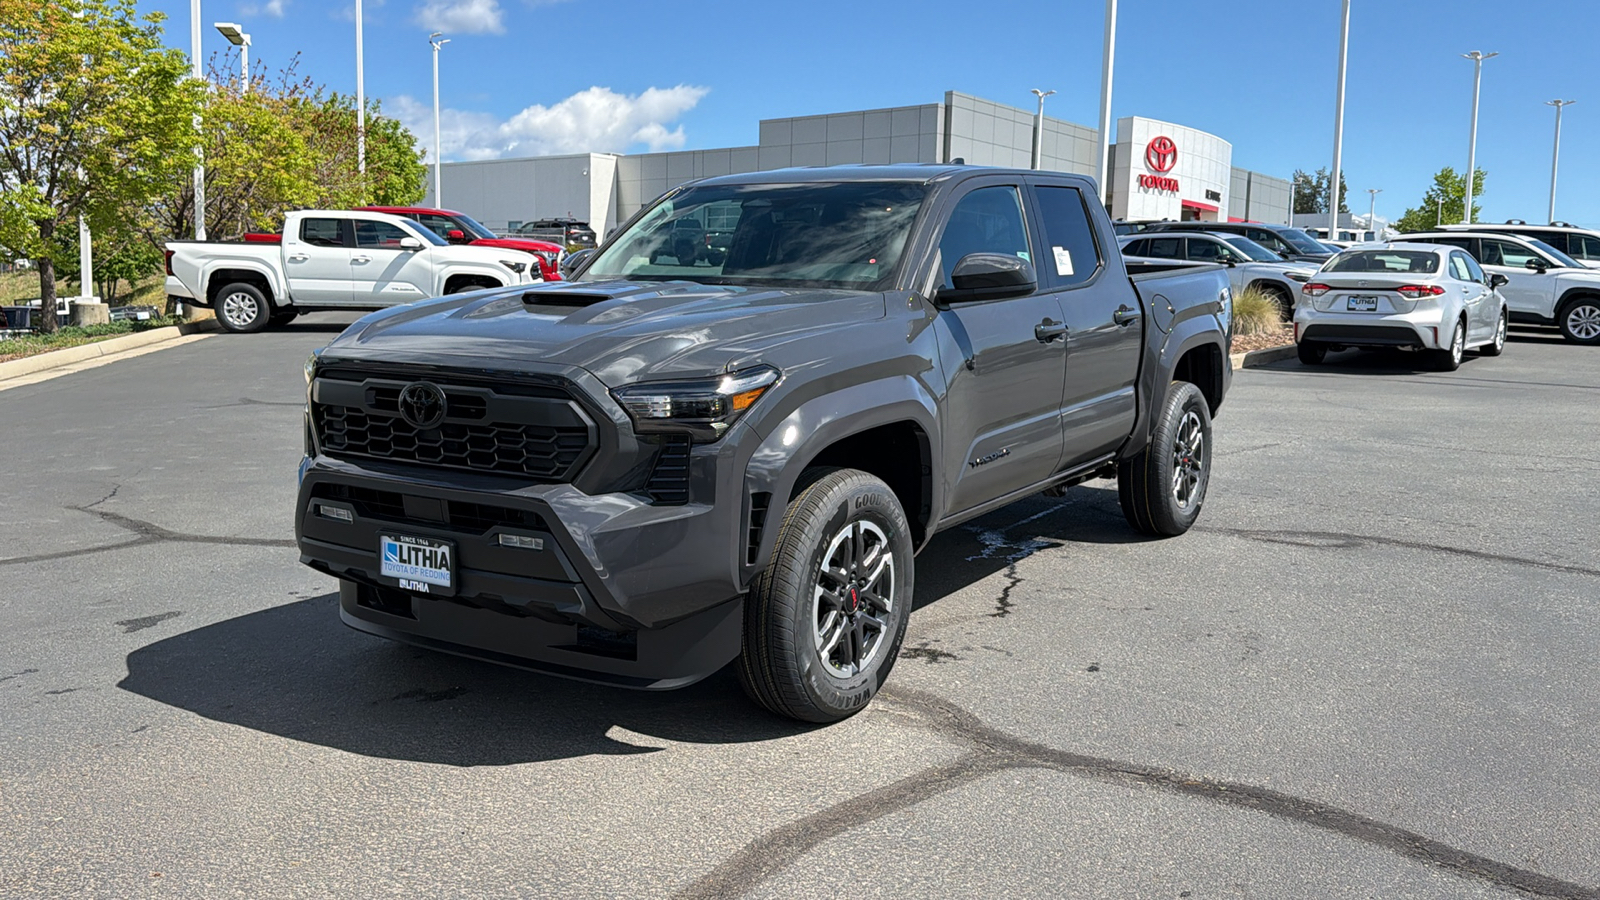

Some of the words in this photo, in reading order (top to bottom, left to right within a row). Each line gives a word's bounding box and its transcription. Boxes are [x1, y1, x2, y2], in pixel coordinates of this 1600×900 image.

[1139, 174, 1179, 192] TOYOTA
[399, 545, 449, 570] LITHIA
[384, 562, 409, 573] TOYOTA
[409, 566, 420, 575] OF
[420, 569, 450, 581] REDDING
[406, 580, 429, 592] LITHIA
